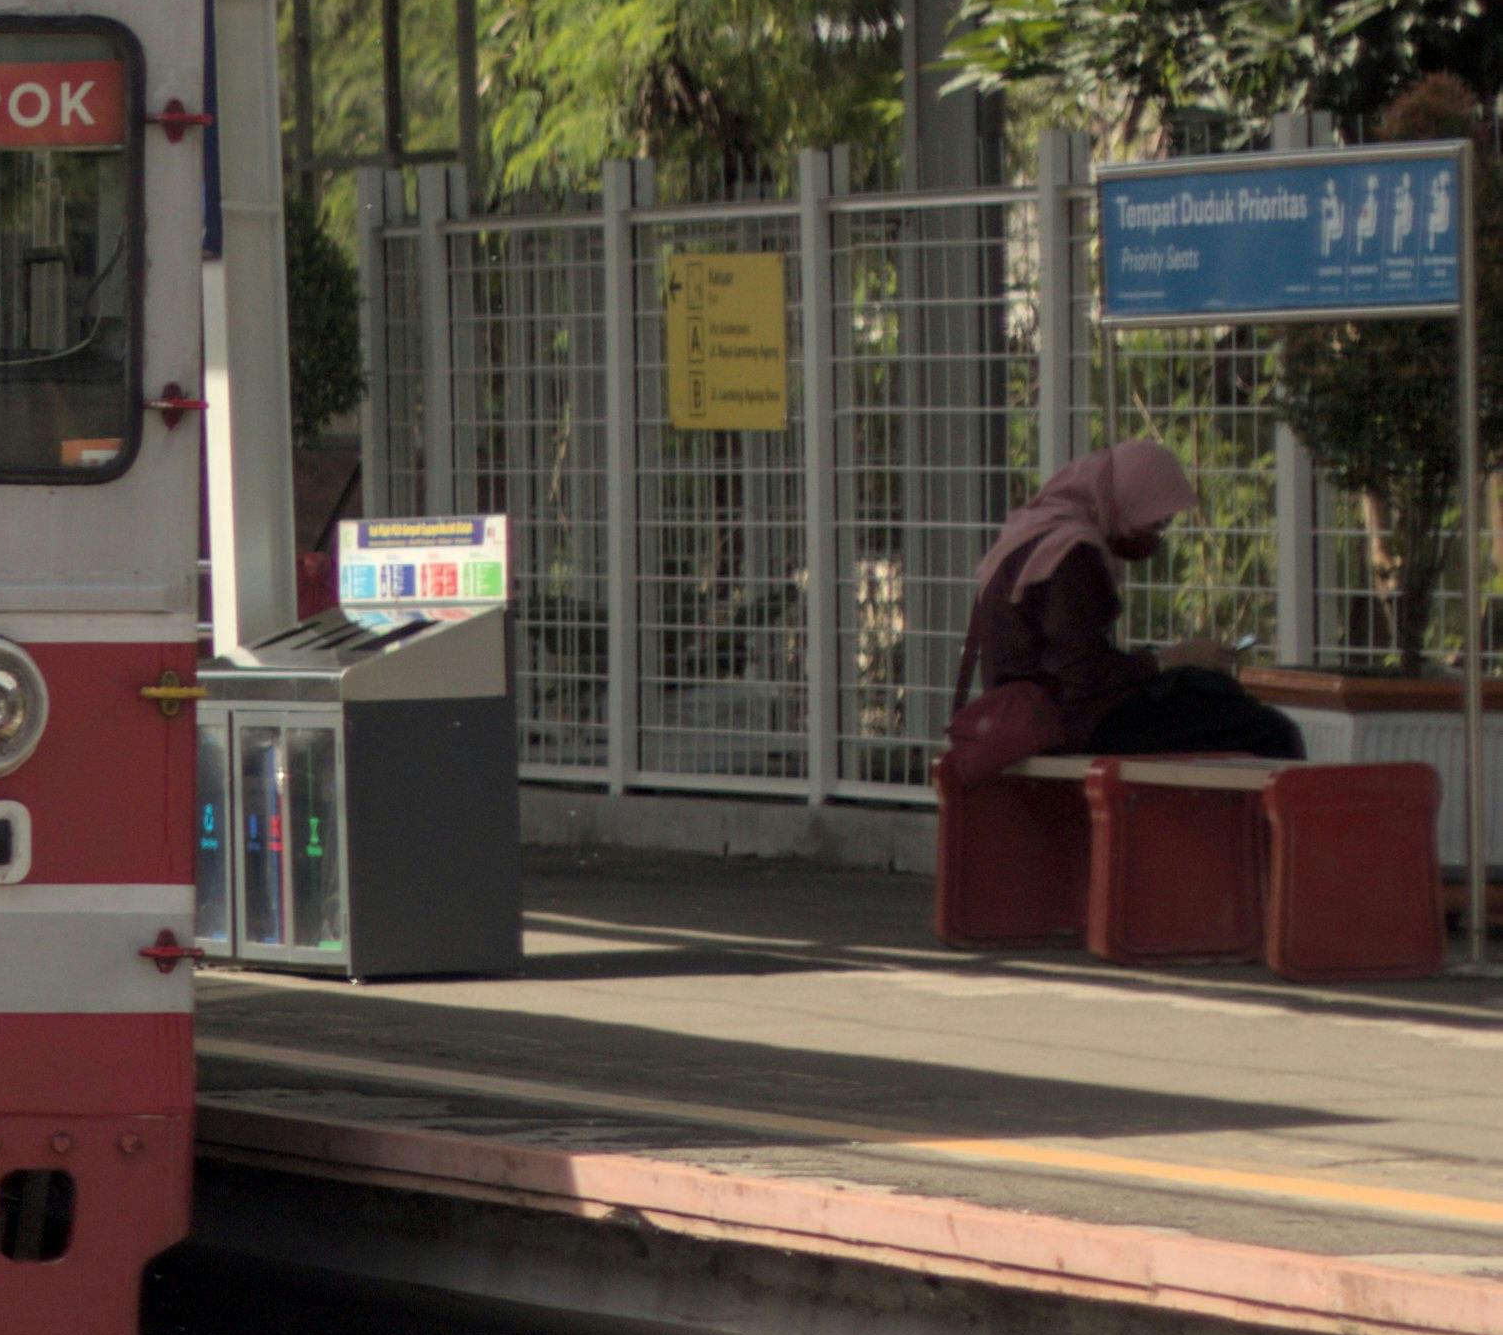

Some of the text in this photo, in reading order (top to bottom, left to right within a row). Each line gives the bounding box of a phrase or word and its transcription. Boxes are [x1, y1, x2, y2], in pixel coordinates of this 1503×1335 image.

[1116, 184, 1308, 235] Tempat Duduk Prioritas
